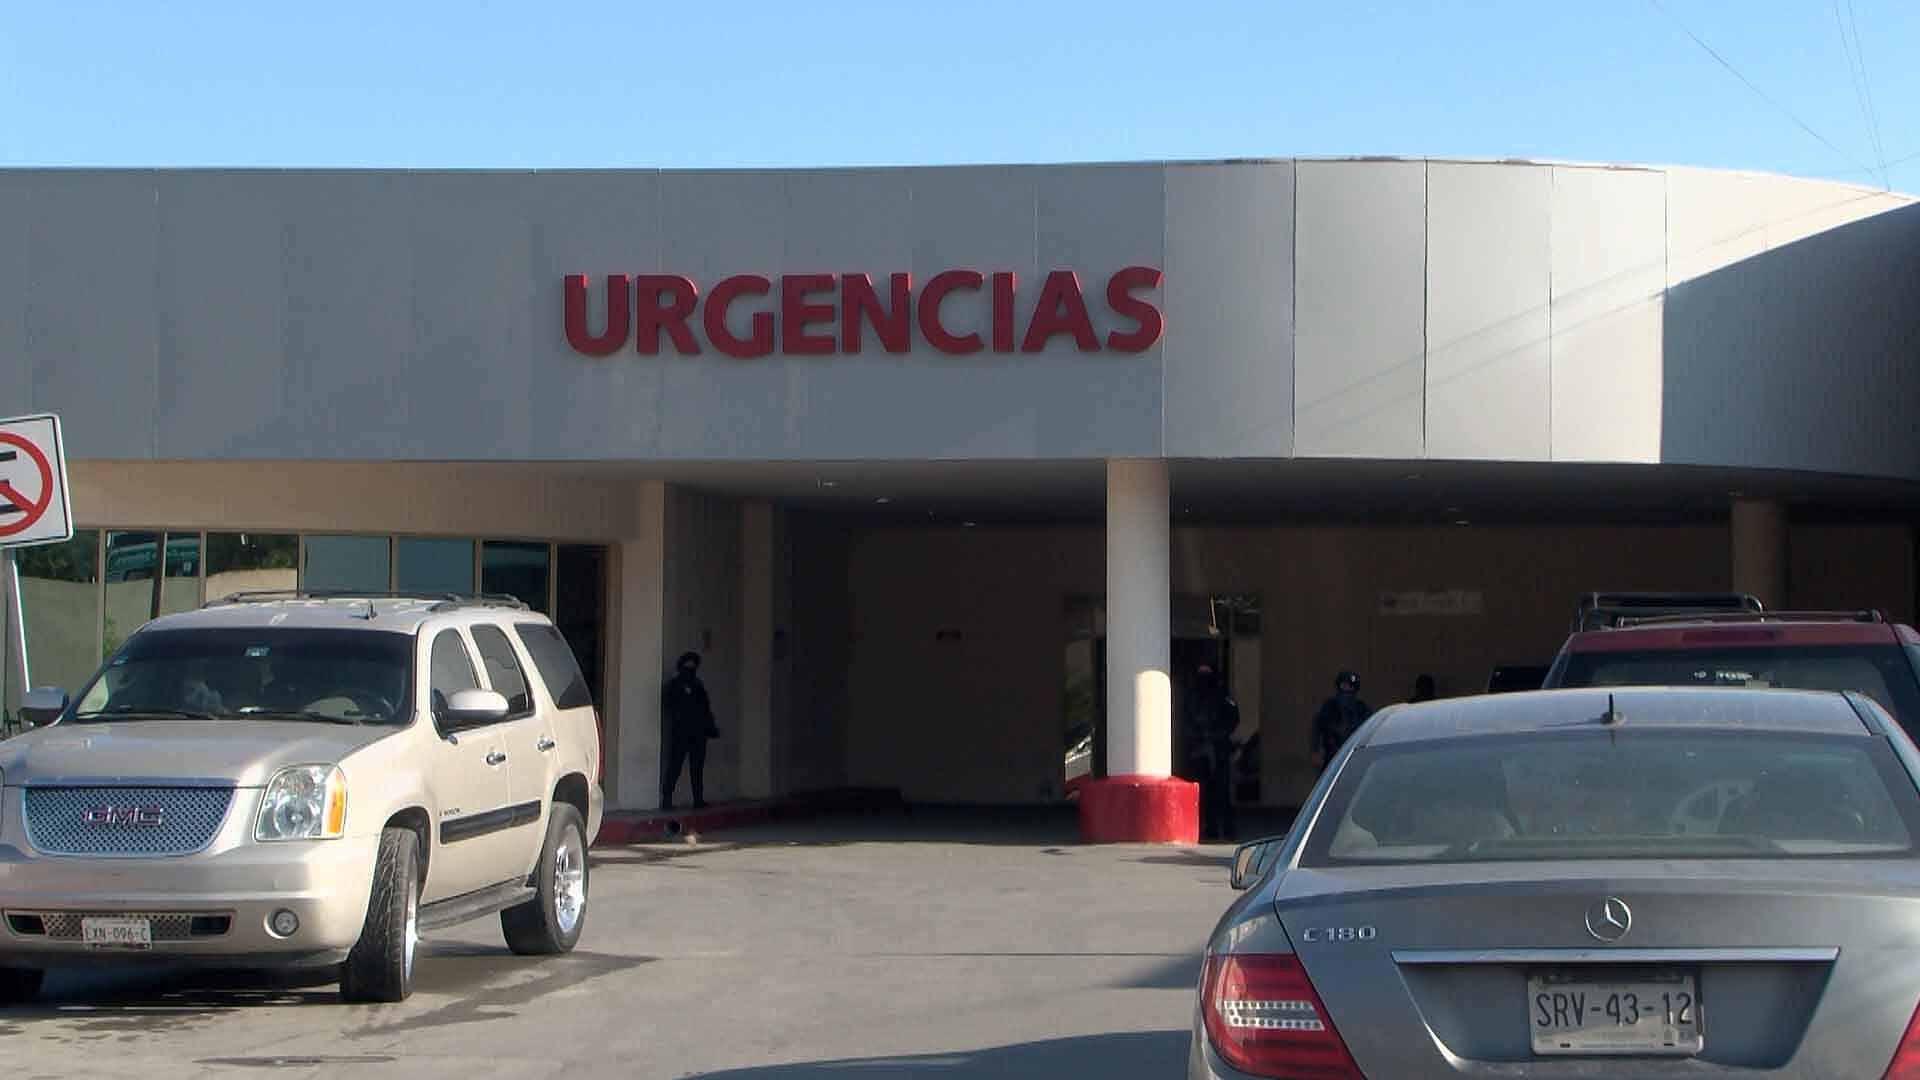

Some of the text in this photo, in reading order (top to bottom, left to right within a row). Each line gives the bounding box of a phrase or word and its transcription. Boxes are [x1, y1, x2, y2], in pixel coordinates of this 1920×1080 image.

[563, 266, 1164, 358] URGENCIAS
[83, 804, 163, 828] GMC
[1327, 926, 1376, 941] 180
[1536, 992, 1693, 1027] SRV-43-12
